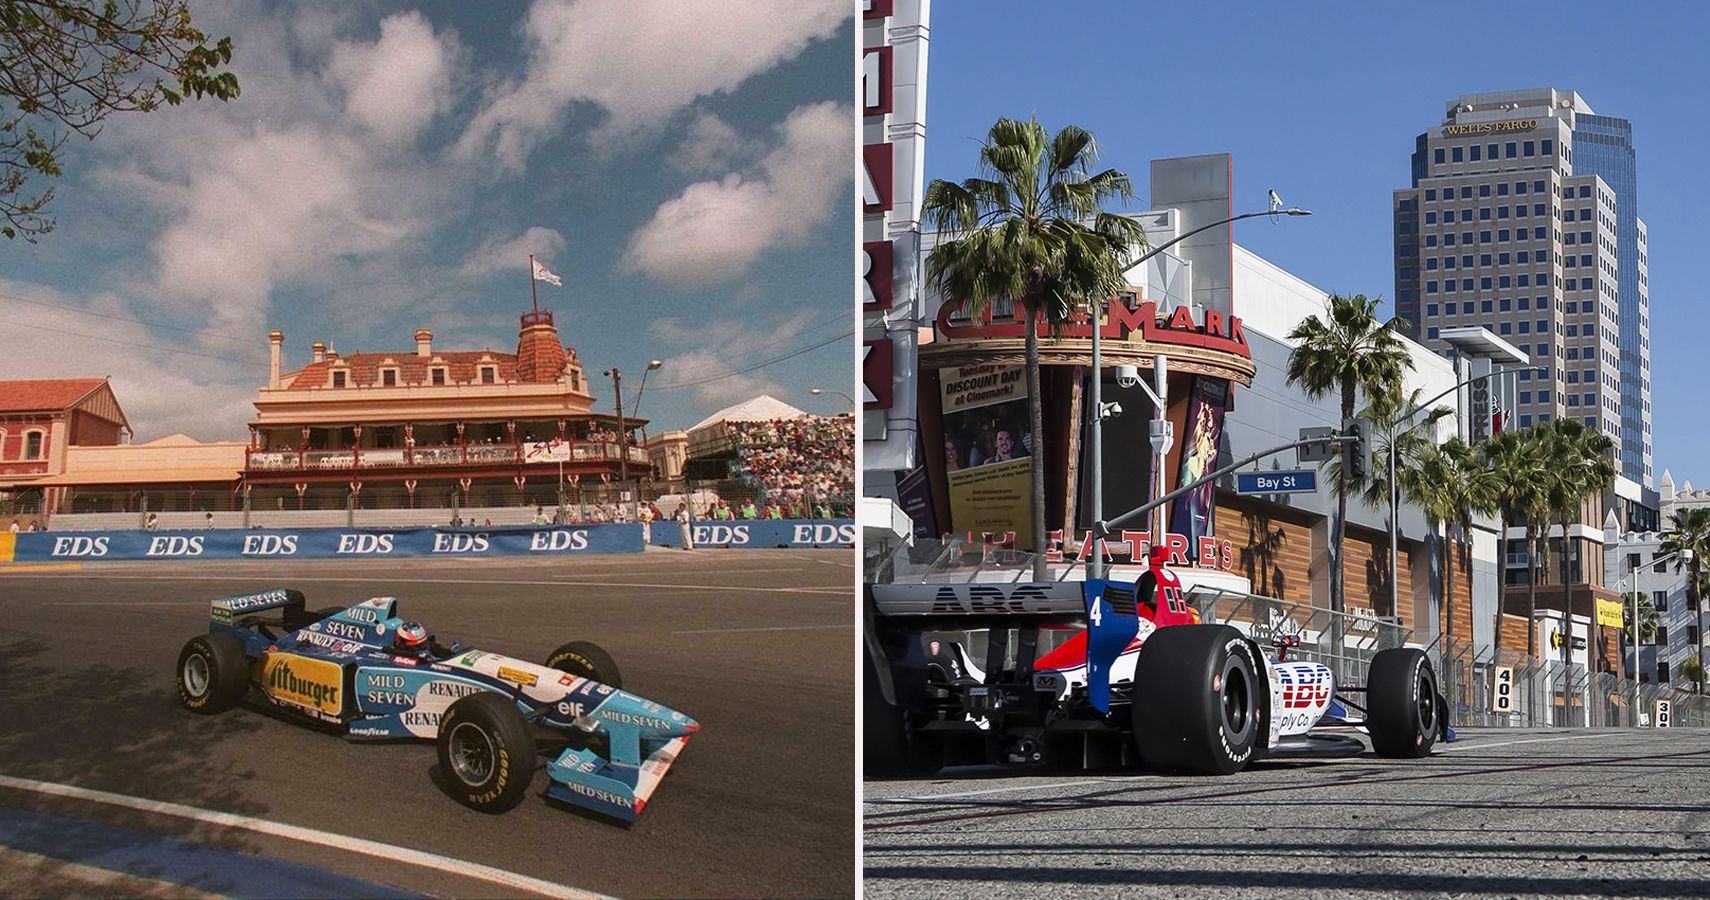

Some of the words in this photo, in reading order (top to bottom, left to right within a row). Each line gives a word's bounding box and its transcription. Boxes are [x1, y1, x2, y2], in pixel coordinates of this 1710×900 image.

[1447, 122, 1492, 135] WELLS
[1495, 119, 1538, 131] FARGO
[946, 374, 998, 395] DISCOUNT
[1001, 369, 1022, 383] DAY
[954, 395, 965, 405] at
[966, 384, 1014, 402] Cinemark!
[1257, 477, 1279, 490] Bay
[1283, 475, 1296, 487] St
[337, 534, 394, 554] EDS
[432, 533, 490, 553] EDS
[529, 530, 588, 551] EDS
[694, 525, 750, 545] EDS
[793, 524, 855, 545] EDS
[51, 537, 109, 556] EDS
[146, 536, 204, 555] EDS
[241, 535, 298, 555] EDS
[249, 590, 289, 606] SEVEN
[344, 607, 377, 623] MILD
[1089, 596, 1102, 627] 4
[325, 621, 366, 641] SEVEN
[342, 642, 364, 654] elf
[368, 675, 405, 688] MILD
[1498, 669, 1511, 709] 400
[368, 690, 415, 706] SEVEN
[405, 712, 442, 726] RENA
[557, 701, 584, 717] elf
[601, 710, 631, 723] MILD
[632, 717, 671, 730] SEVEN
[568, 781, 596, 797] MILD
[596, 790, 633, 809] SEVEN
